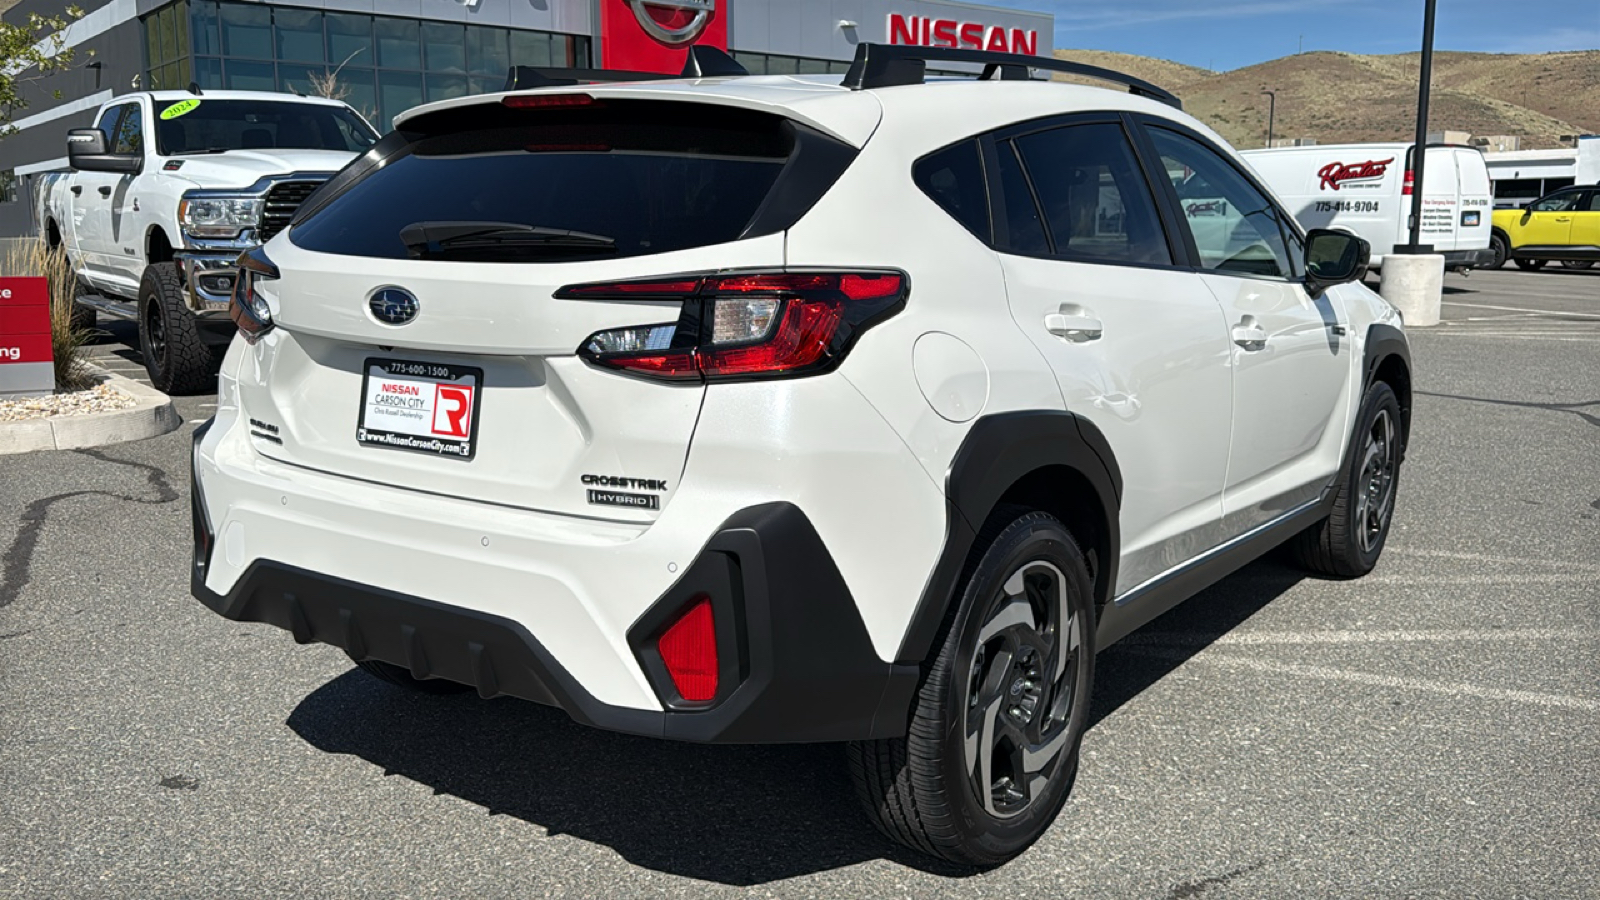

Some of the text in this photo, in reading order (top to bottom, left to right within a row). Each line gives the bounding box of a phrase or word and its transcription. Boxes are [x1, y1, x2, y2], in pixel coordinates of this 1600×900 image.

[888, 13, 1037, 56] NISSAN
[167, 100, 192, 116] 2024
[1315, 201, 1379, 212] 775-414-9704
[391, 363, 449, 377] 775-600-1500
[381, 383, 420, 396] NISSAN
[374, 393, 425, 409] CARSON CITY
[367, 433, 460, 453] www.NissanCarsonCity.com
[580, 474, 668, 491] CROSSTREK
[597, 494, 647, 505] HYBRID
